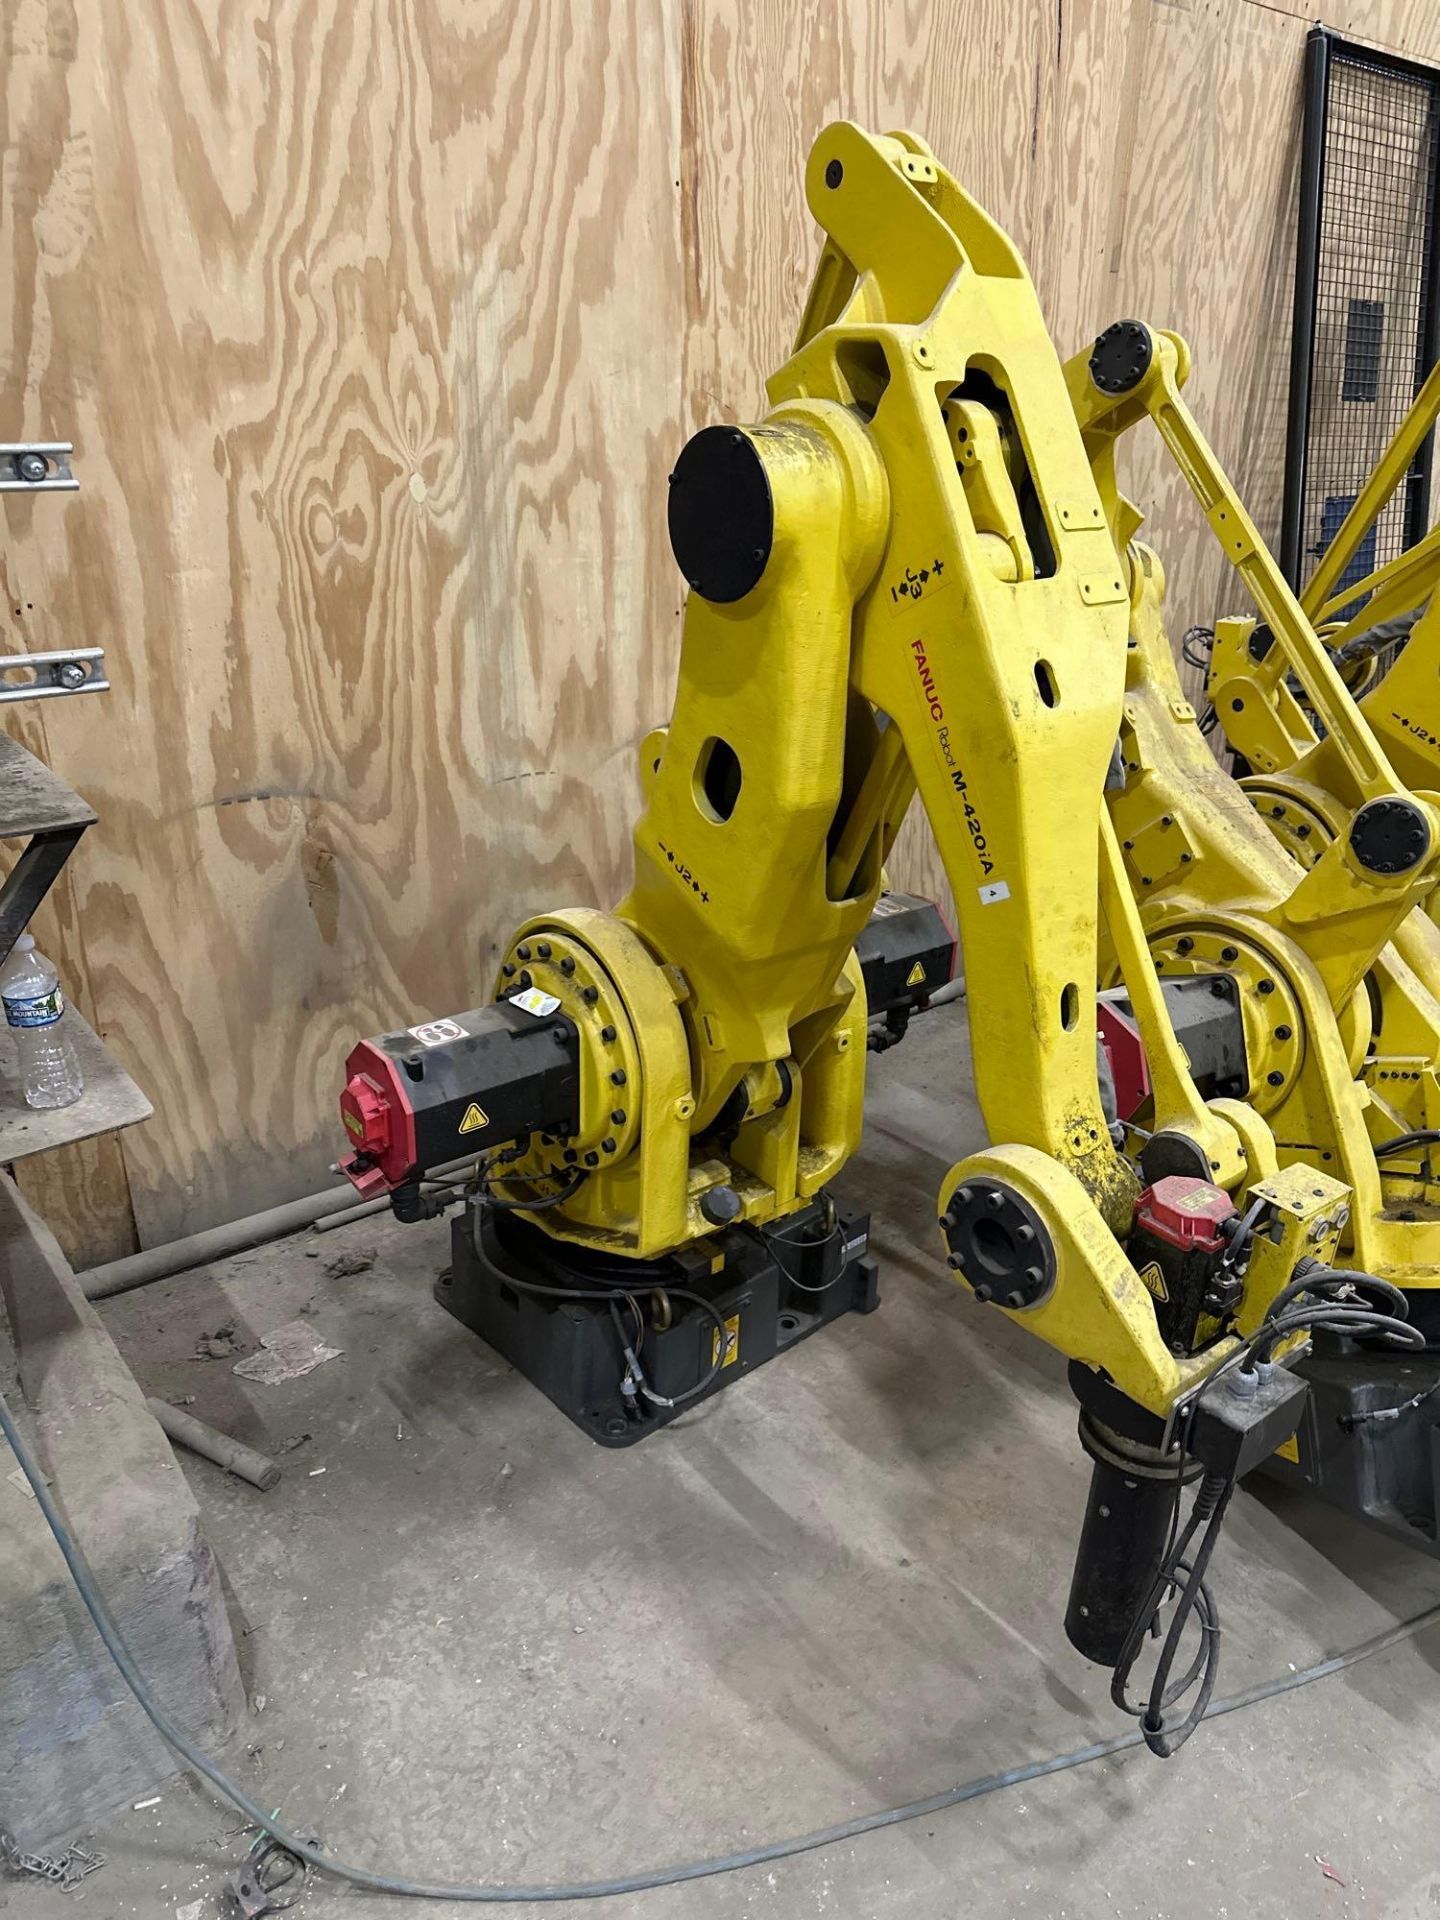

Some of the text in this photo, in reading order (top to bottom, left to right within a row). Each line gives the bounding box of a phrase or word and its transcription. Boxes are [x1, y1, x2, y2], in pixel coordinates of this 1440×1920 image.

[905, 567, 922, 600] J3
[1409, 726, 1429, 741] J2
[911, 639, 994, 875] FANUC Robot M-420iA
[674, 864, 692, 884] J2
